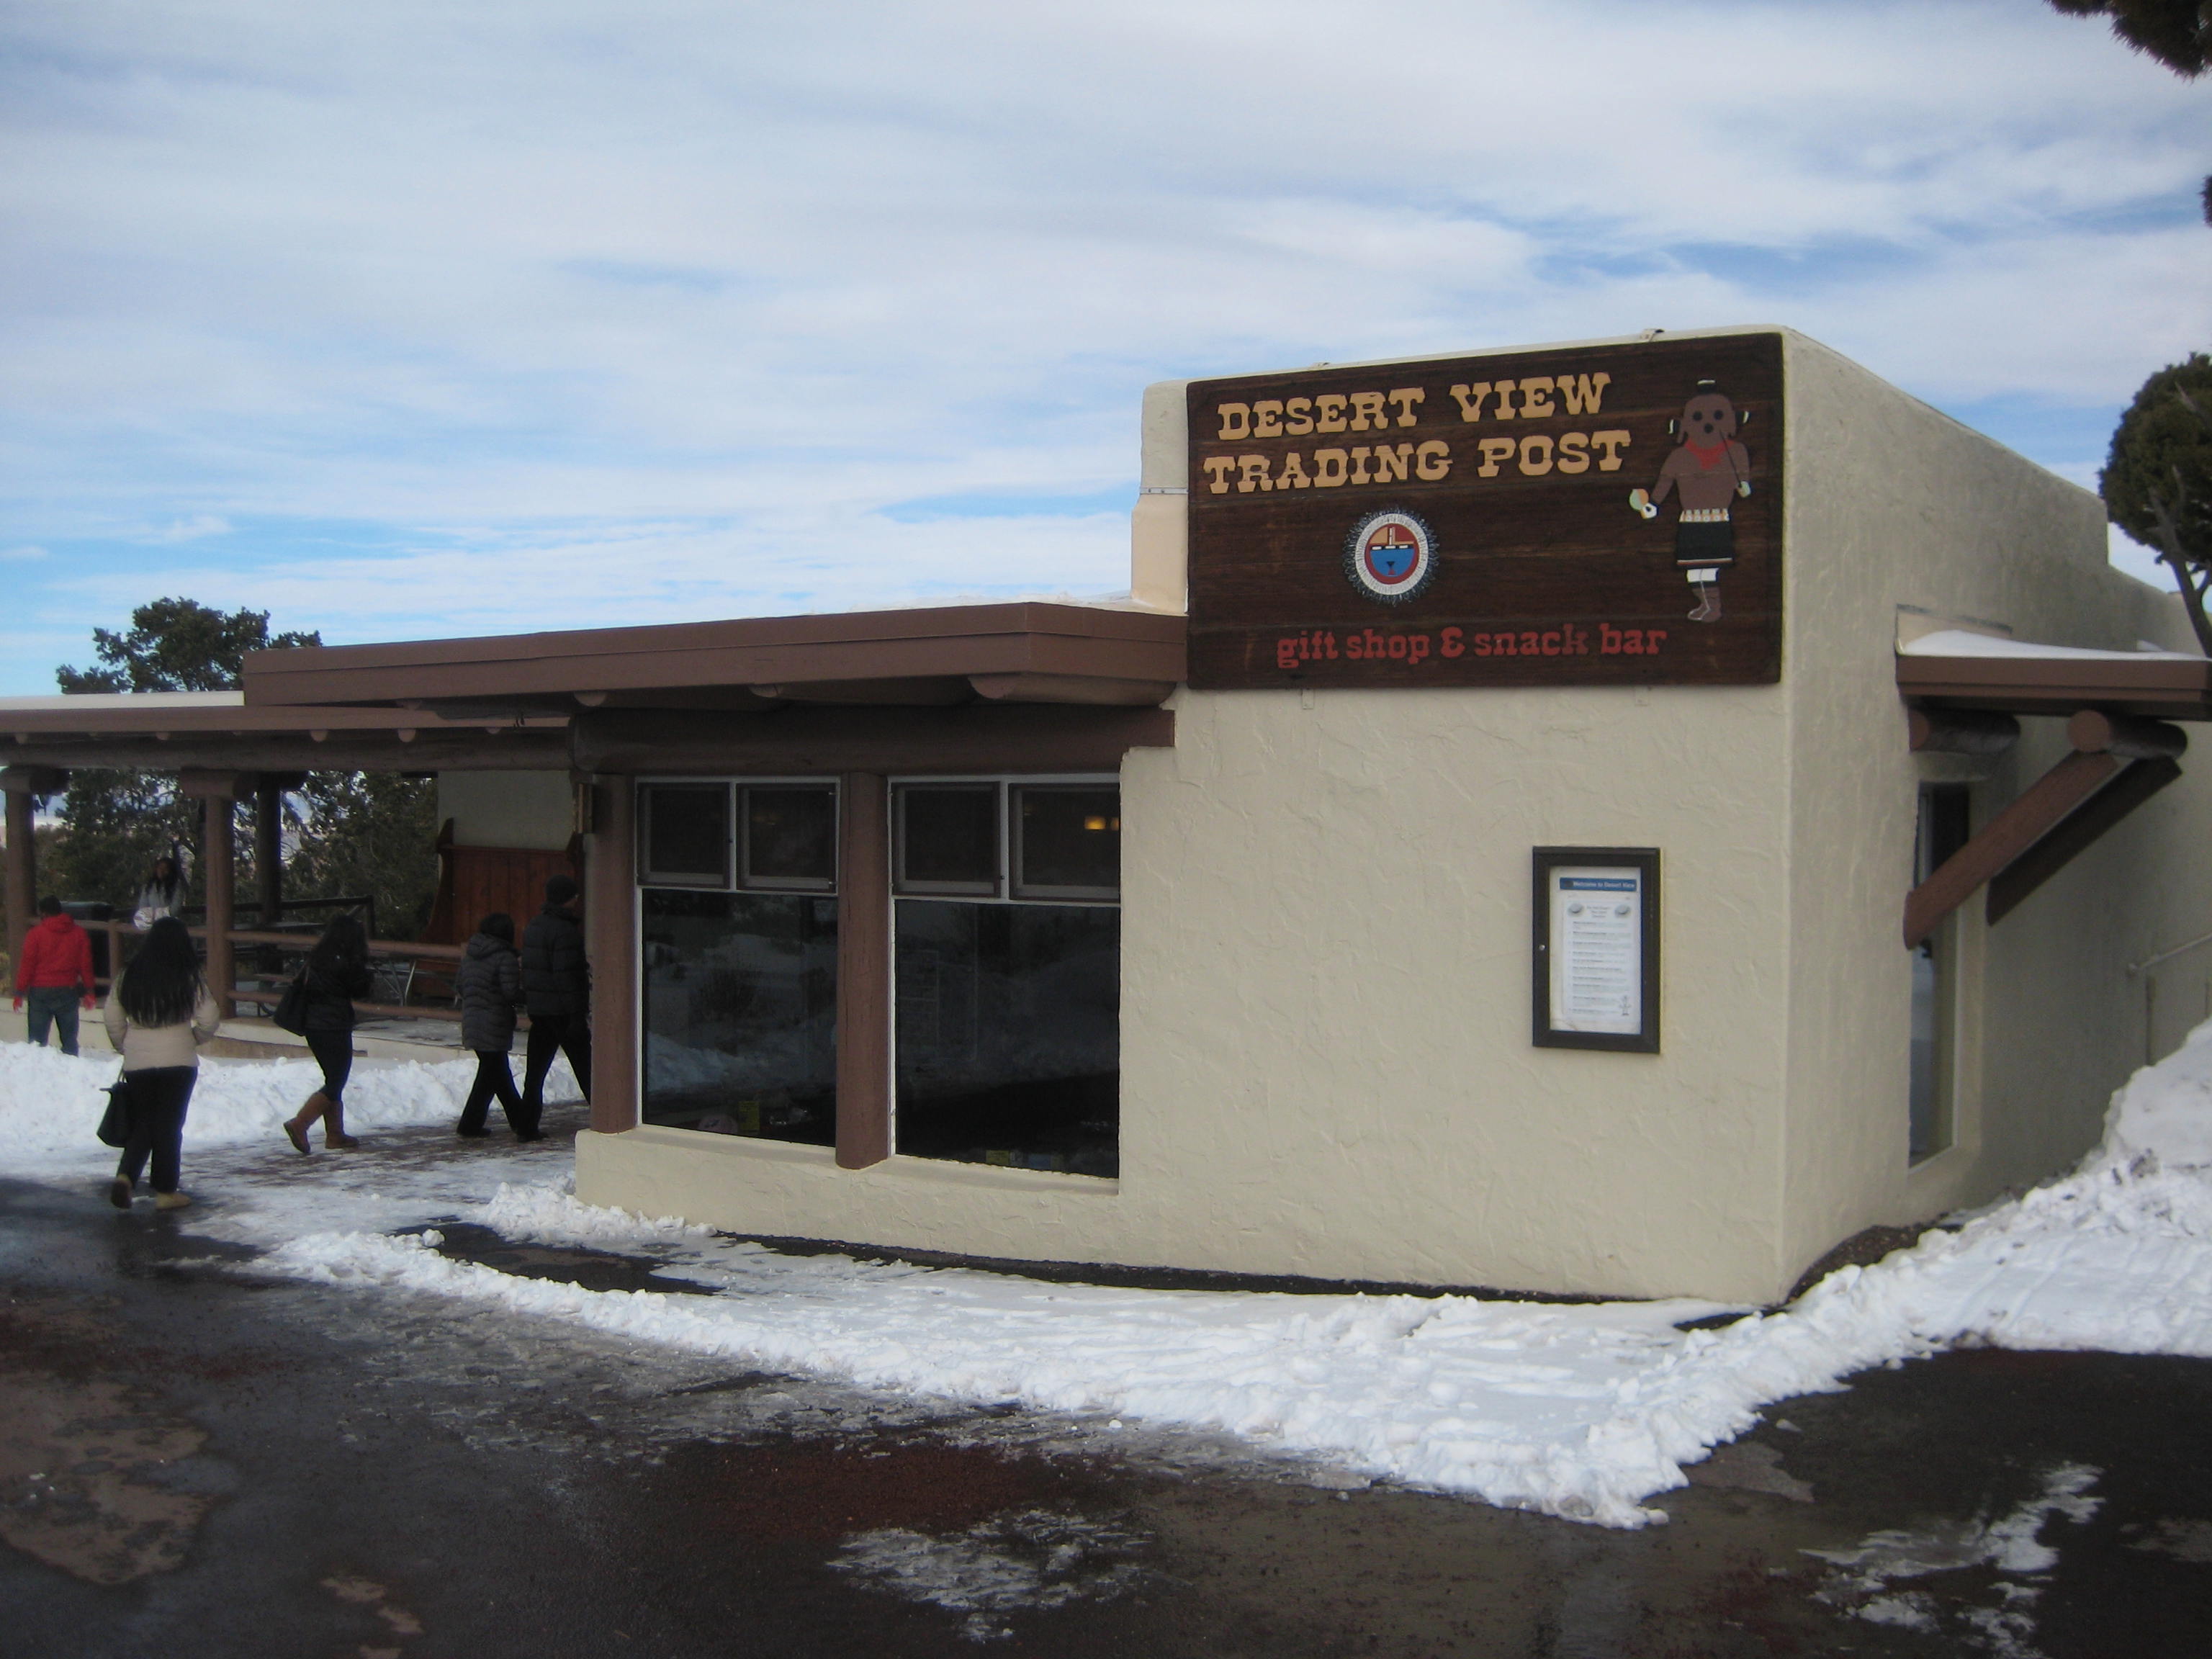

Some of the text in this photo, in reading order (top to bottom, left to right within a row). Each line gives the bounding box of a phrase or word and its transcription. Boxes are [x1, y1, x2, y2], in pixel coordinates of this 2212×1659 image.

[1217, 372, 1611, 441] DESERT VIEW
[1203, 429, 1631, 495] TRADING POST
[1276, 629, 1339, 669] gift
[1346, 628, 1431, 665] shop
[1474, 622, 1588, 657] snack
[1599, 622, 1668, 656] bar
